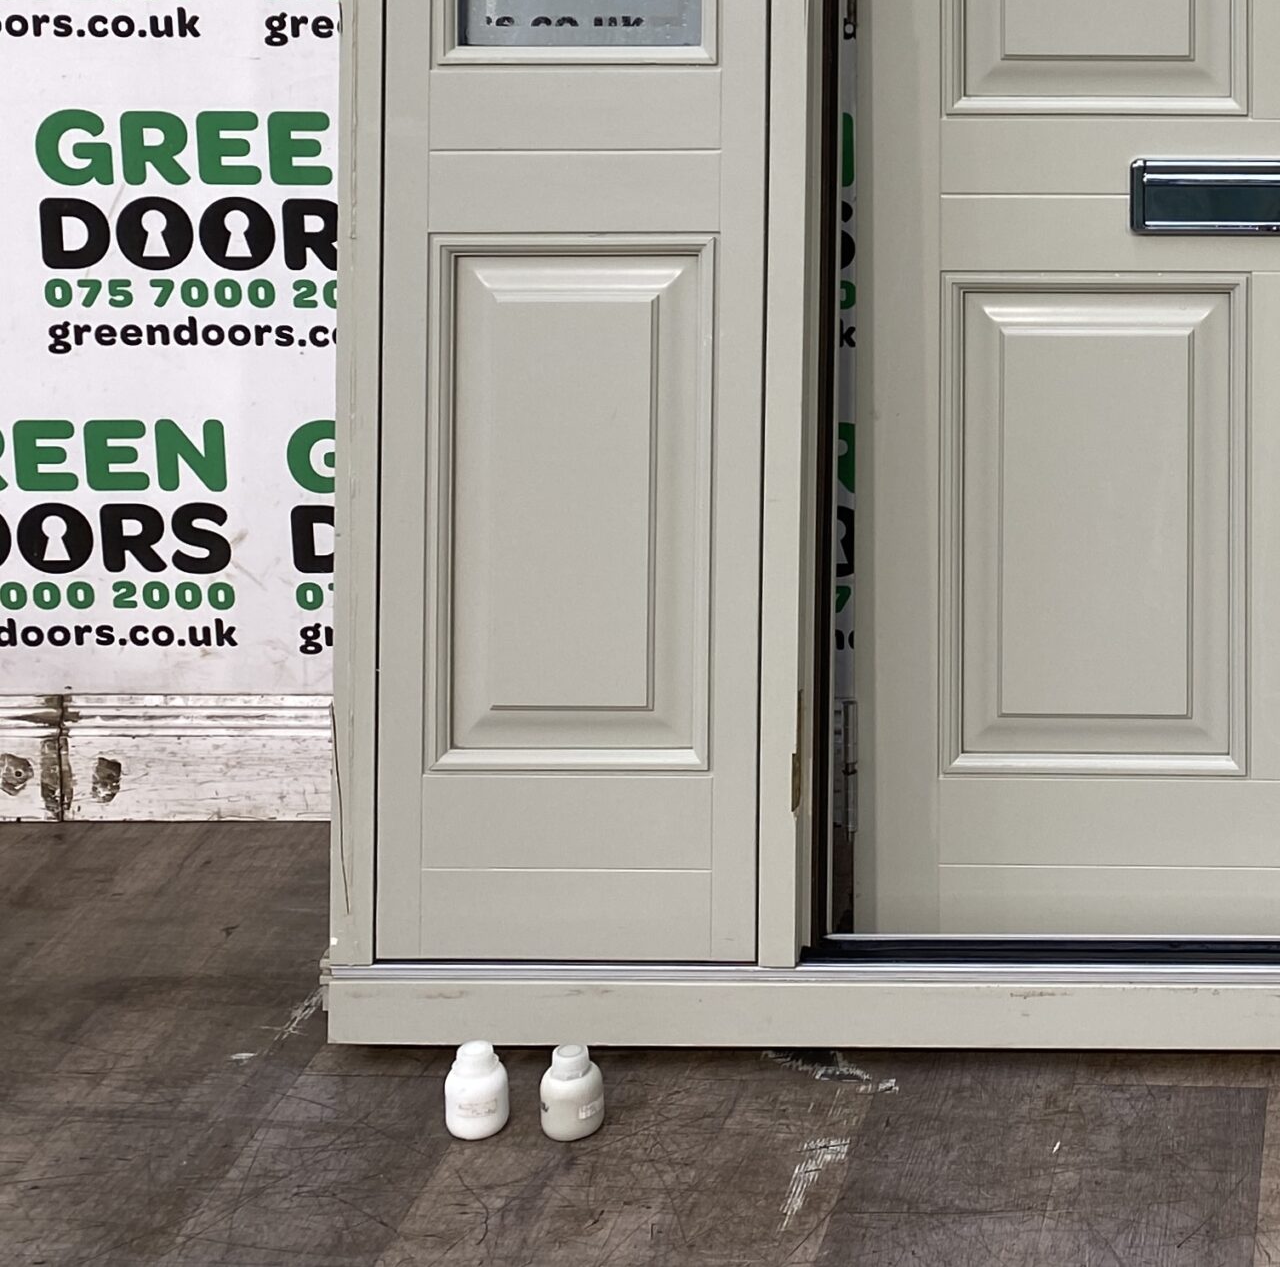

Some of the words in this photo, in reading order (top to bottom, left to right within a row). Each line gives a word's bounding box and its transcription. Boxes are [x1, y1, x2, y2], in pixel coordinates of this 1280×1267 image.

[0, 7, 199, 37] ors.co.uk
[265, 12, 341, 46] gre
[36, 109, 332, 186] GREE
[40, 197, 338, 271] DOOR
[45, 279, 133, 307] 075
[150, 279, 275, 308] 7000
[49, 316, 336, 354] greendoors.c
[0, 419, 227, 492] EEN
[0, 503, 231, 574] ORS
[113, 581, 235, 610] 2000
[296, 583, 334, 610] 0
